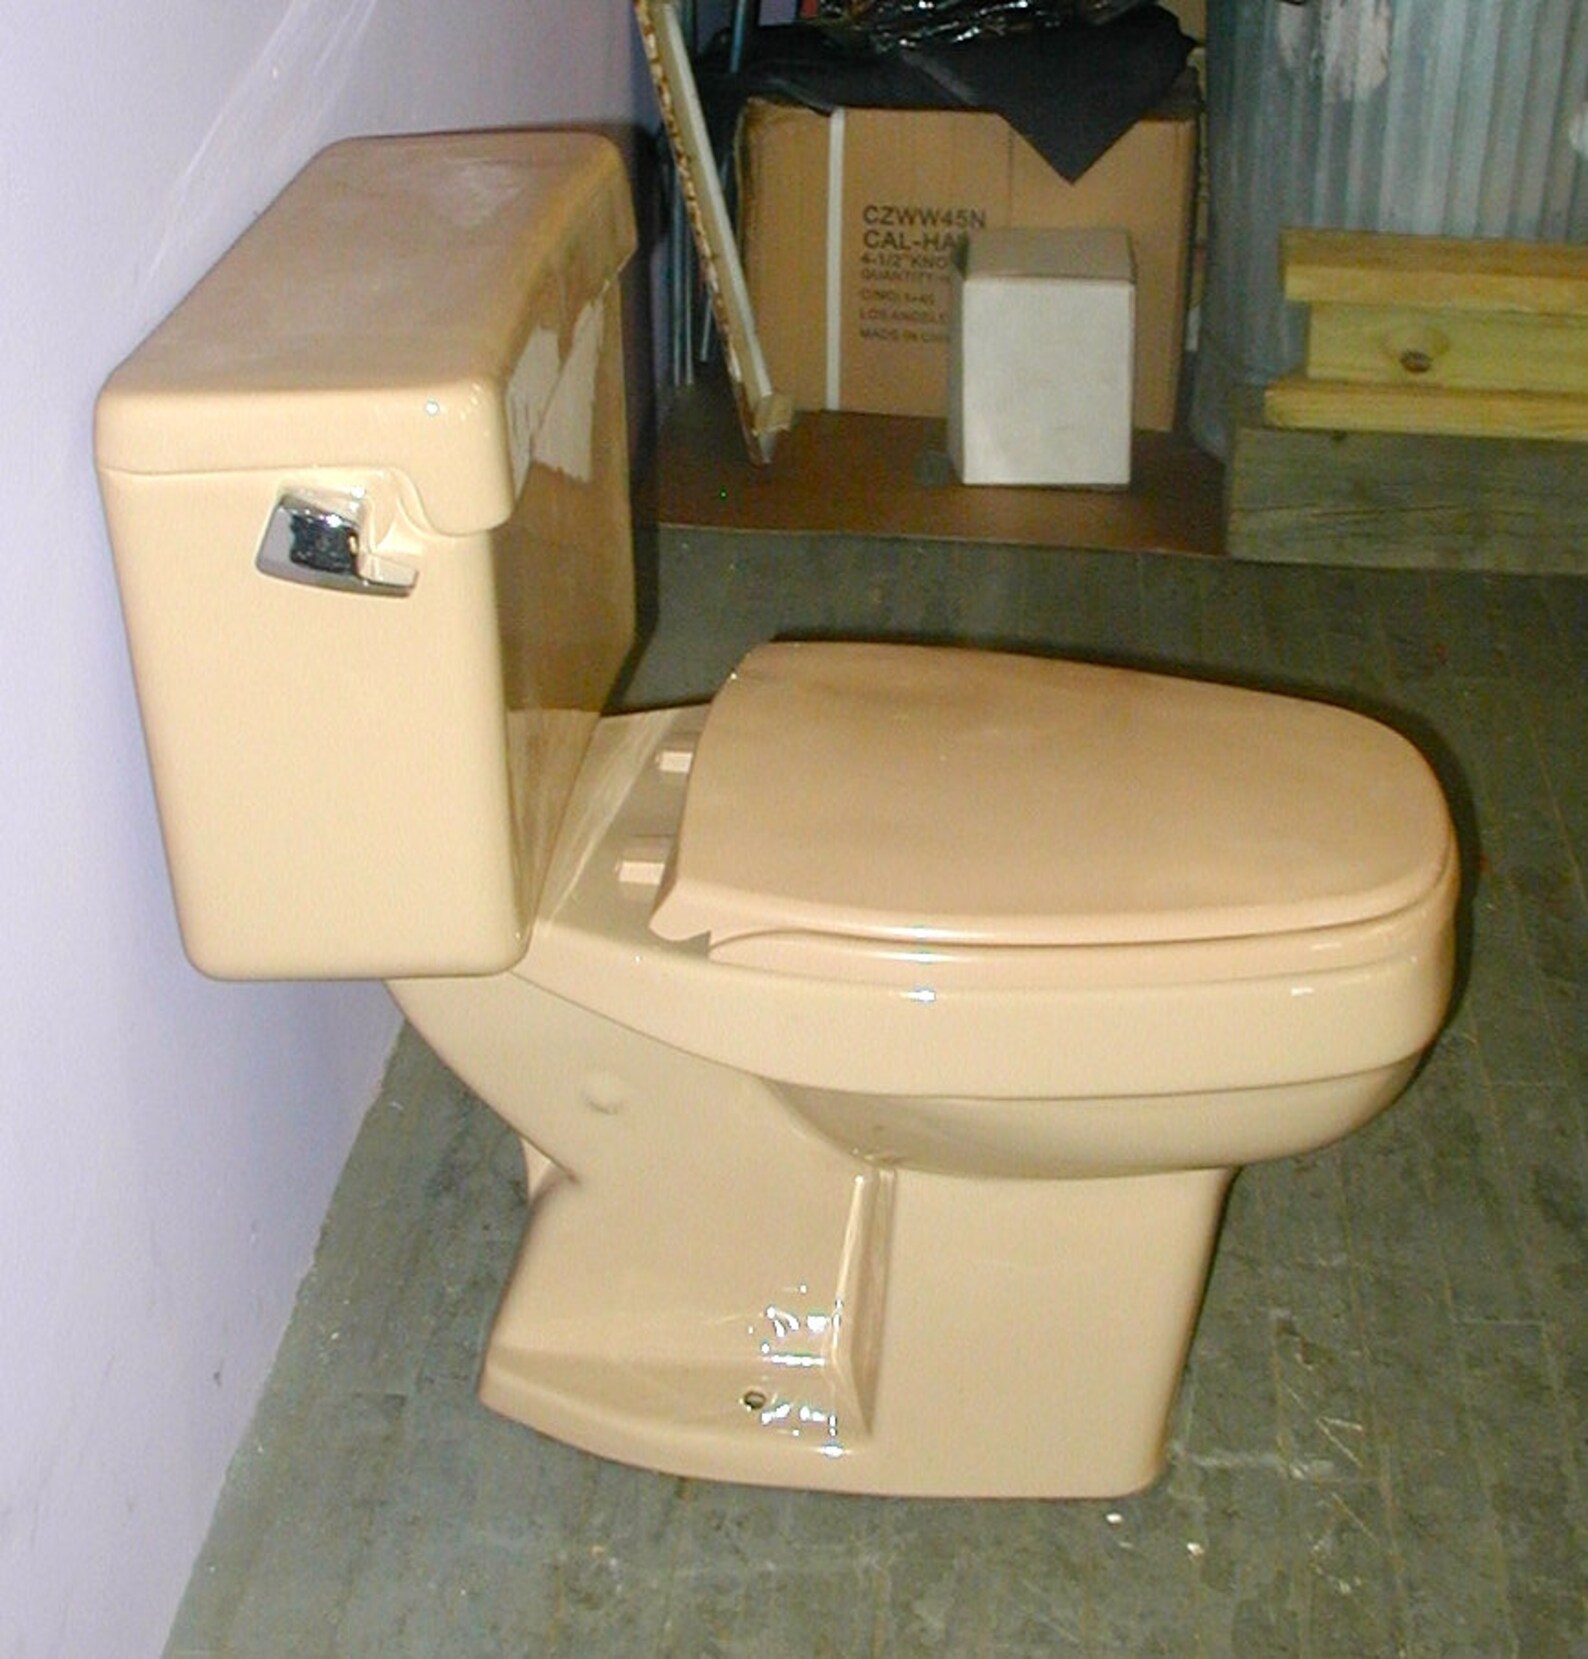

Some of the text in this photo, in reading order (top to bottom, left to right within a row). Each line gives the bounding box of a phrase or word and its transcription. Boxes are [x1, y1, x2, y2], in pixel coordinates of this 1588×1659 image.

[863, 205, 987, 229] CZWW45N
[863, 229, 957, 251] CAL-HA
[911, 254, 949, 270] KNO
